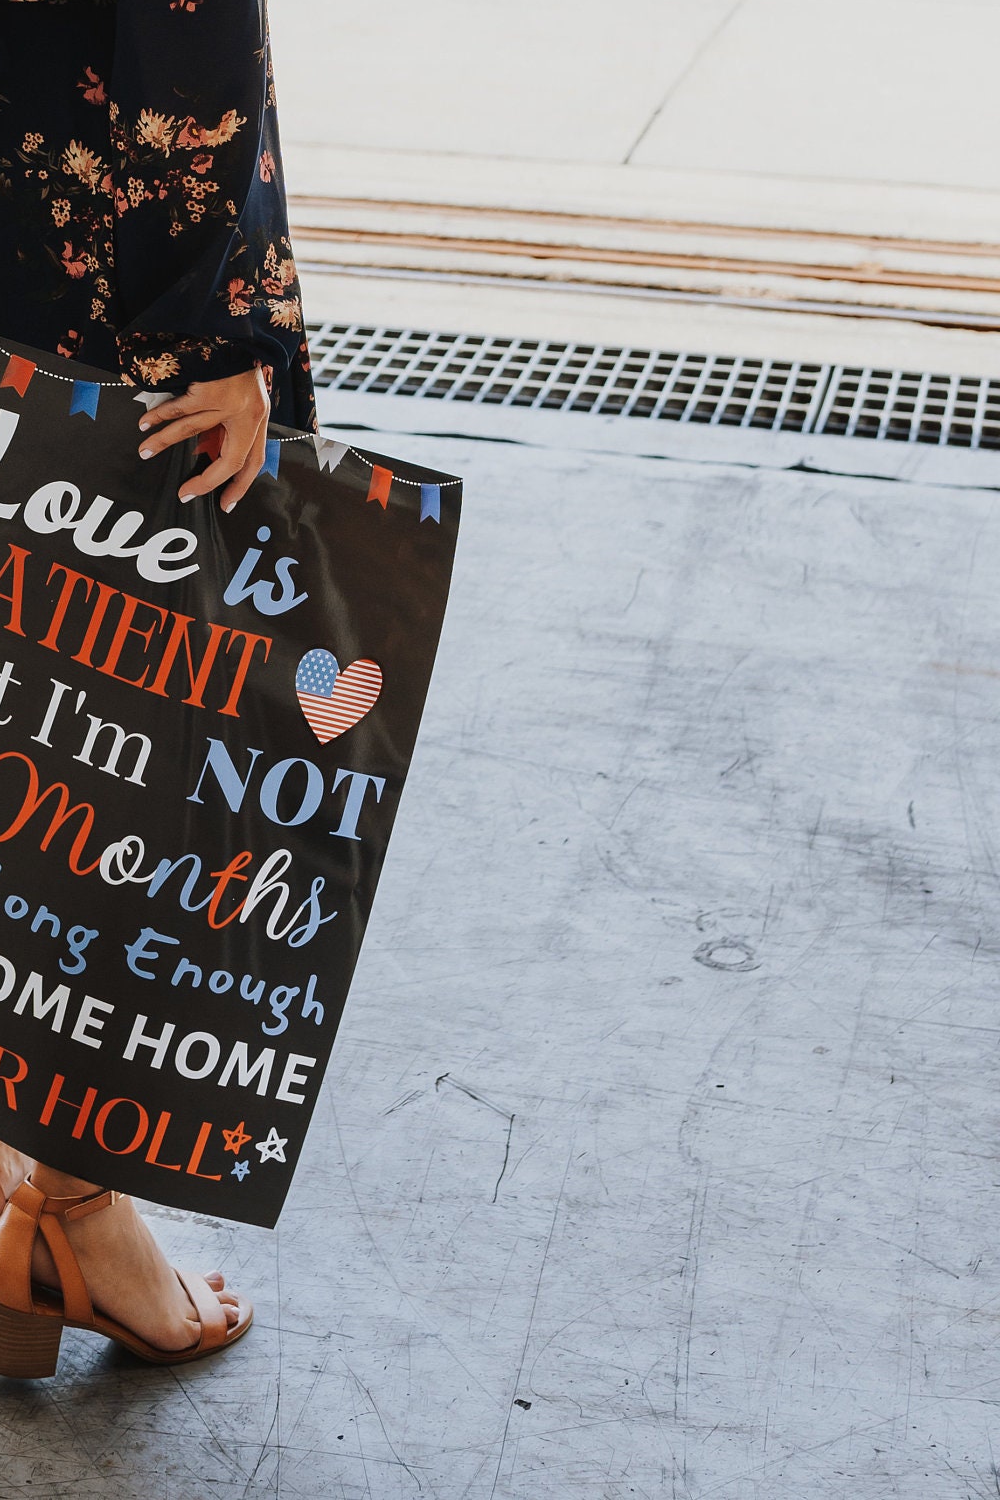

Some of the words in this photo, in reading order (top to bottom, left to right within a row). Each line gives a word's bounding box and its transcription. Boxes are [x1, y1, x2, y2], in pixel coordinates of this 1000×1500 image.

[223, 526, 308, 615] is
[30, 677, 153, 787] I'm
[186, 738, 386, 840] NOT
[124, 927, 324, 1036] Enough
[122, 1014, 317, 1104] HOME
[39, 1072, 222, 1181] HOLL
